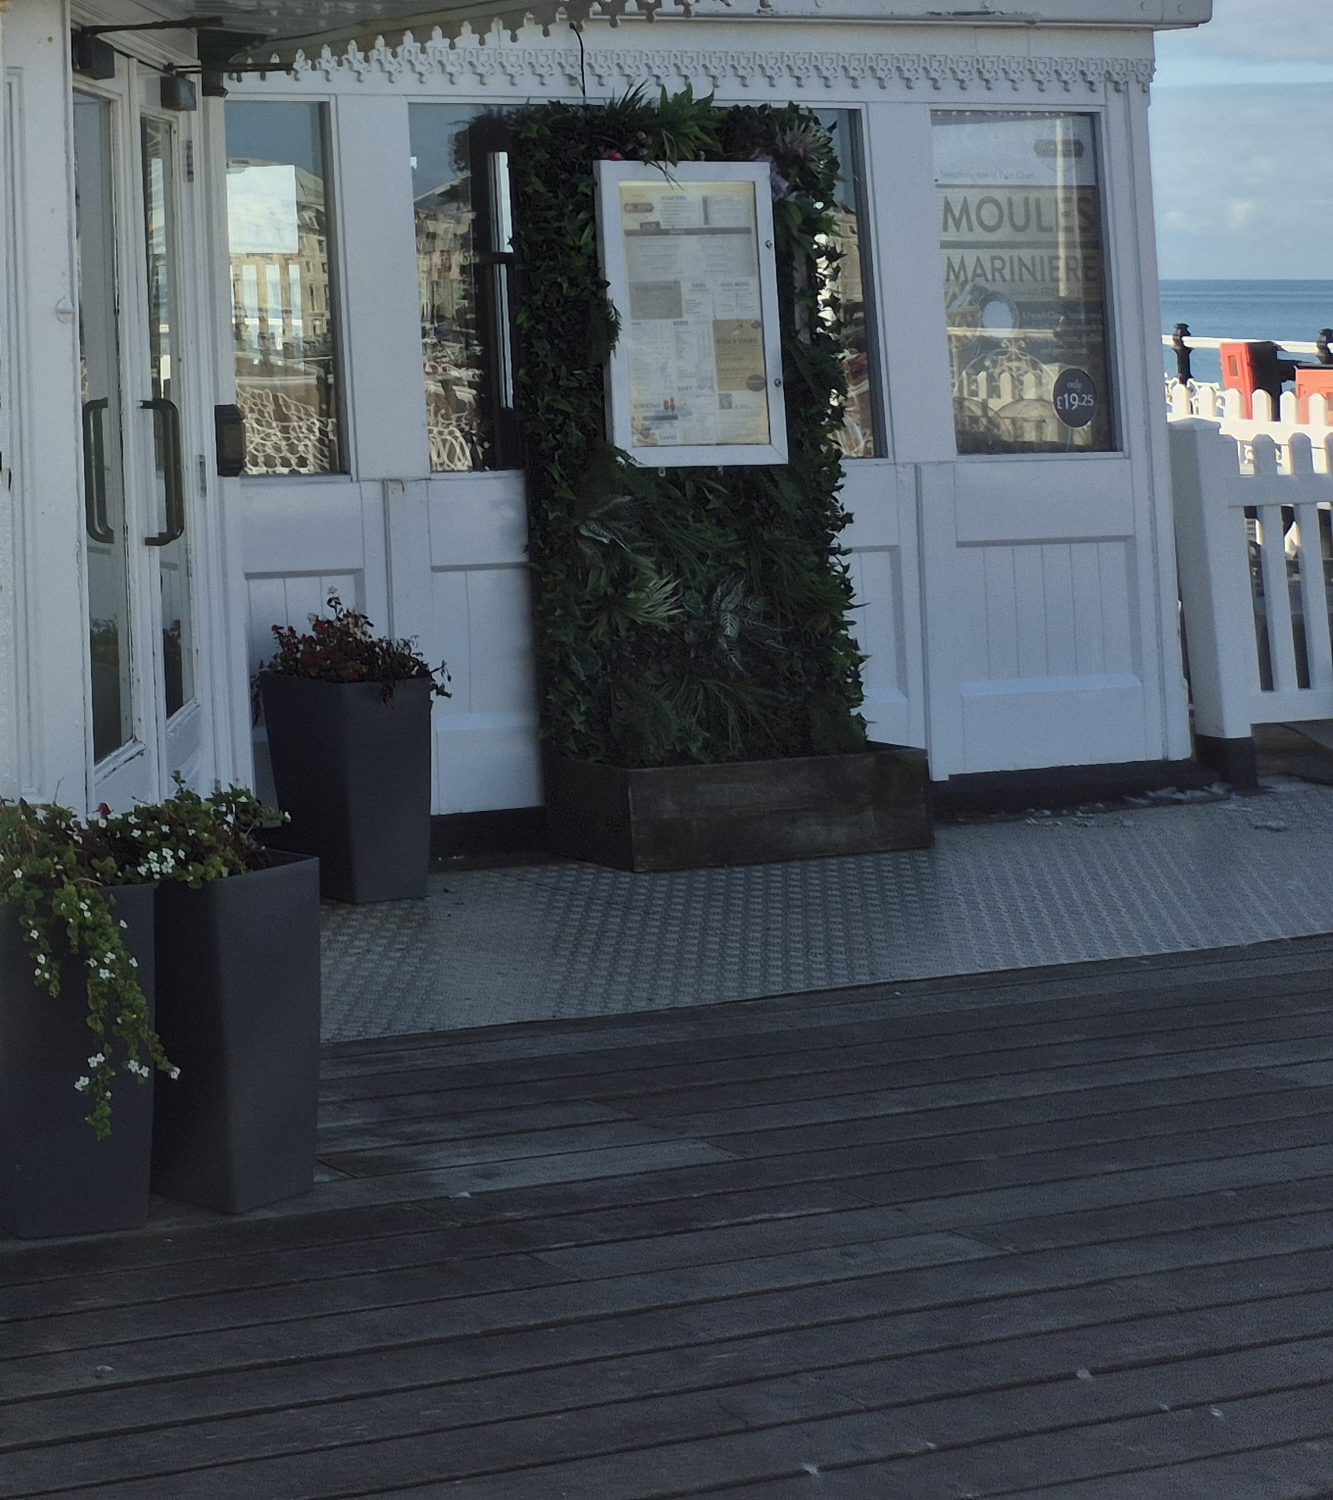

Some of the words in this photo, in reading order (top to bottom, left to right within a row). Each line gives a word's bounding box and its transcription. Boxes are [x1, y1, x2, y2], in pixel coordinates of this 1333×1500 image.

[942, 195, 1096, 233] MOULES
[945, 255, 1101, 283] MARINIERE
[1066, 379, 1082, 391] only
[1056, 392, 1094, 411] £19.25
